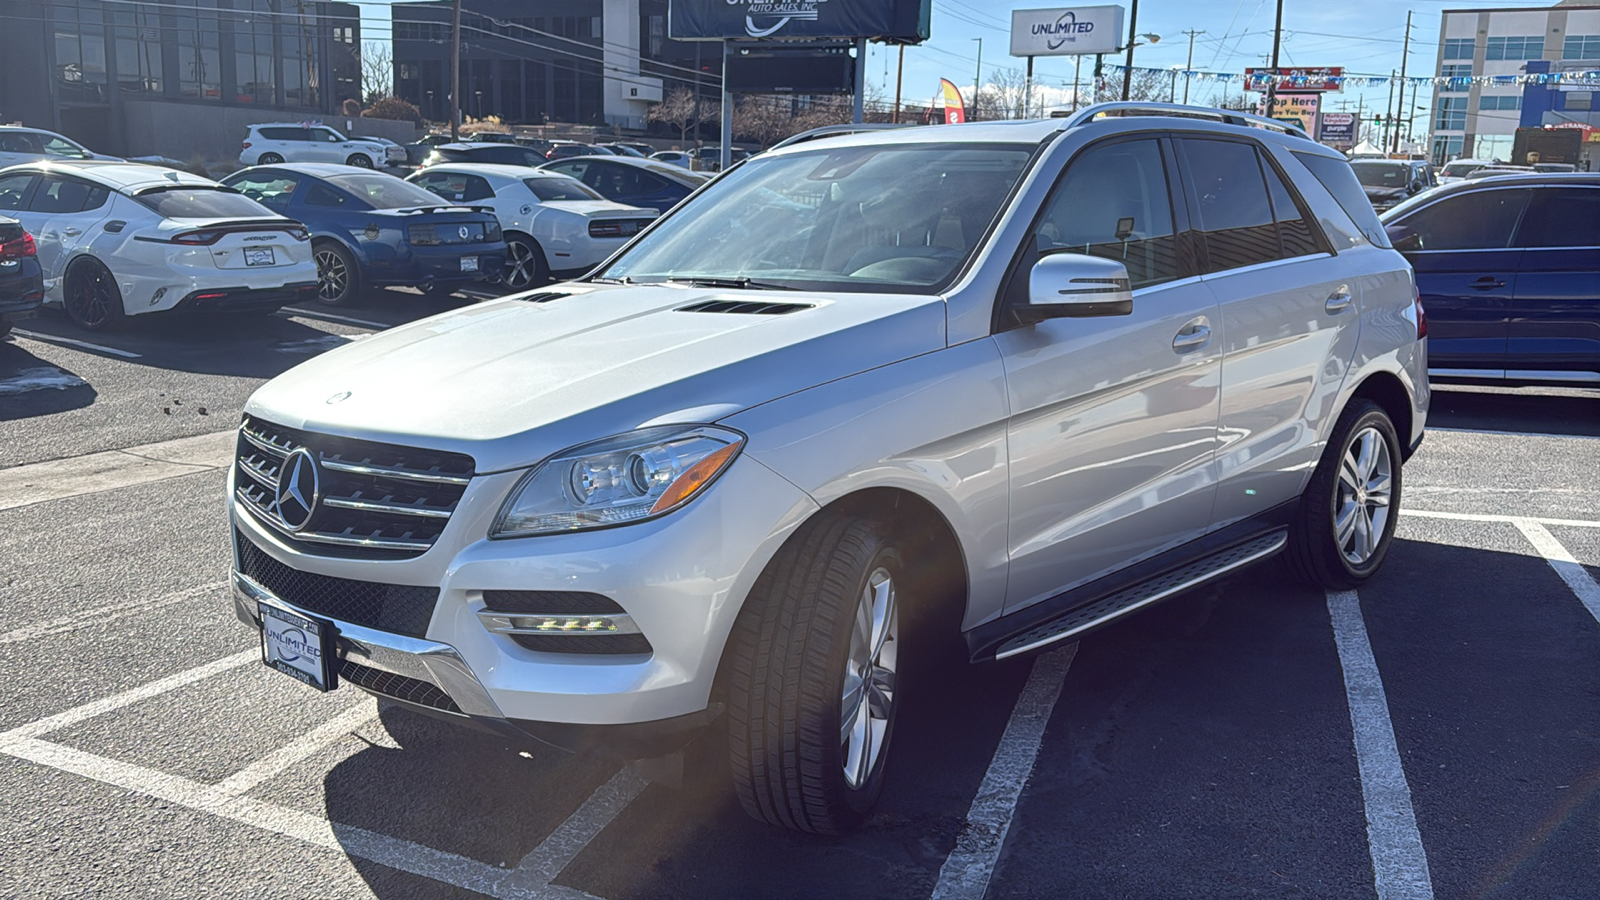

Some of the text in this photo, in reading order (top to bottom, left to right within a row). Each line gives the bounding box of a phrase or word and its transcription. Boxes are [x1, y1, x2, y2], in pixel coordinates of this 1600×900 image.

[747, 4, 772, 13] AUTO
[1031, 22, 1094, 35] UNLIMITED
[1260, 97, 1317, 107] Sop Here
[266, 628, 321, 657] UNLIMITED
